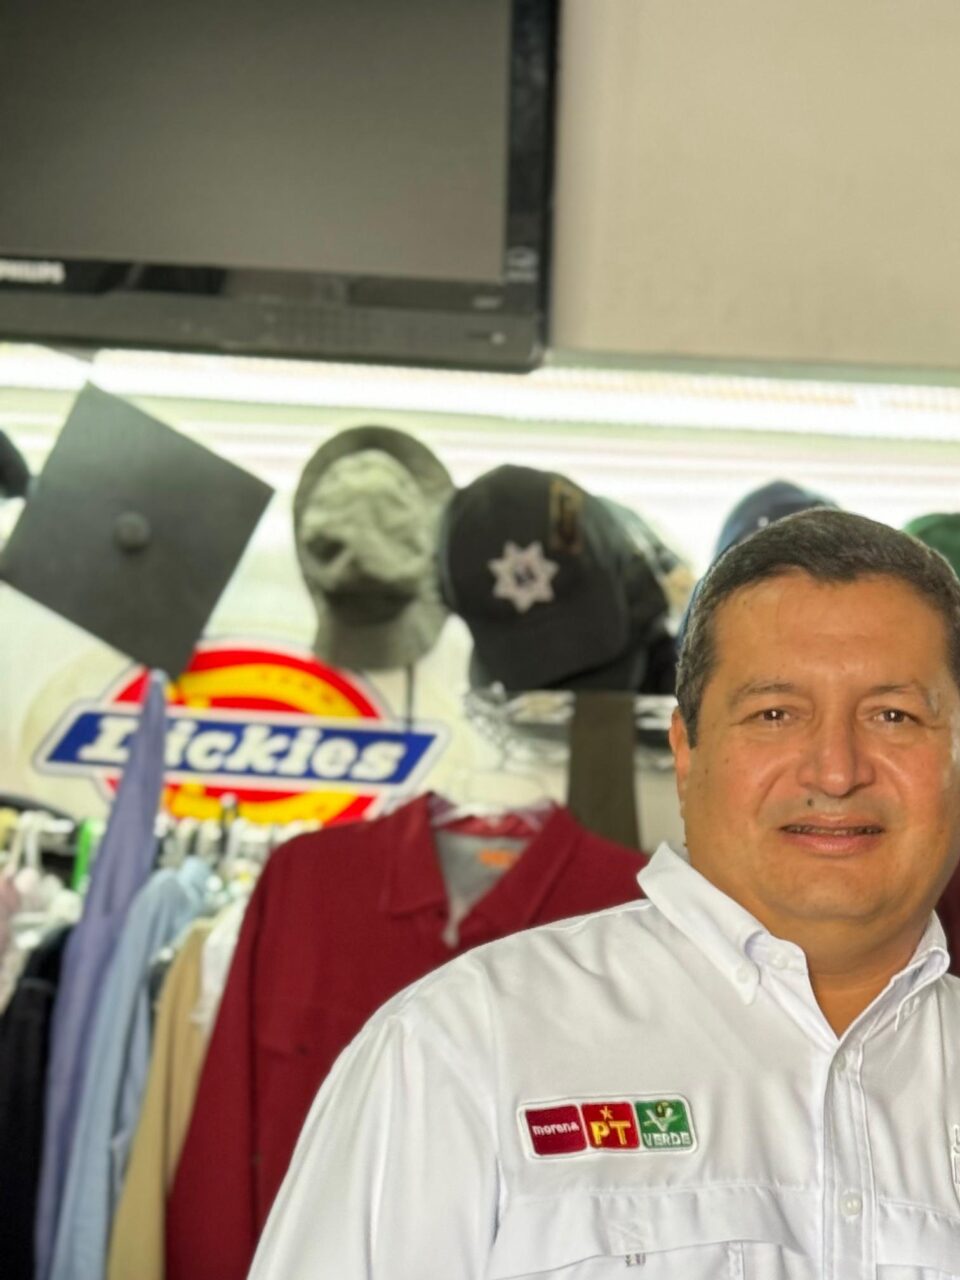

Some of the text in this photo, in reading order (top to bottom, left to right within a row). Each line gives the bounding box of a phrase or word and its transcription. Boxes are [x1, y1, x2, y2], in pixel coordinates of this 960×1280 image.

[532, 1121, 580, 1136] morena
[590, 1121, 631, 1145] PT
[643, 1133, 692, 1146] VERDE
